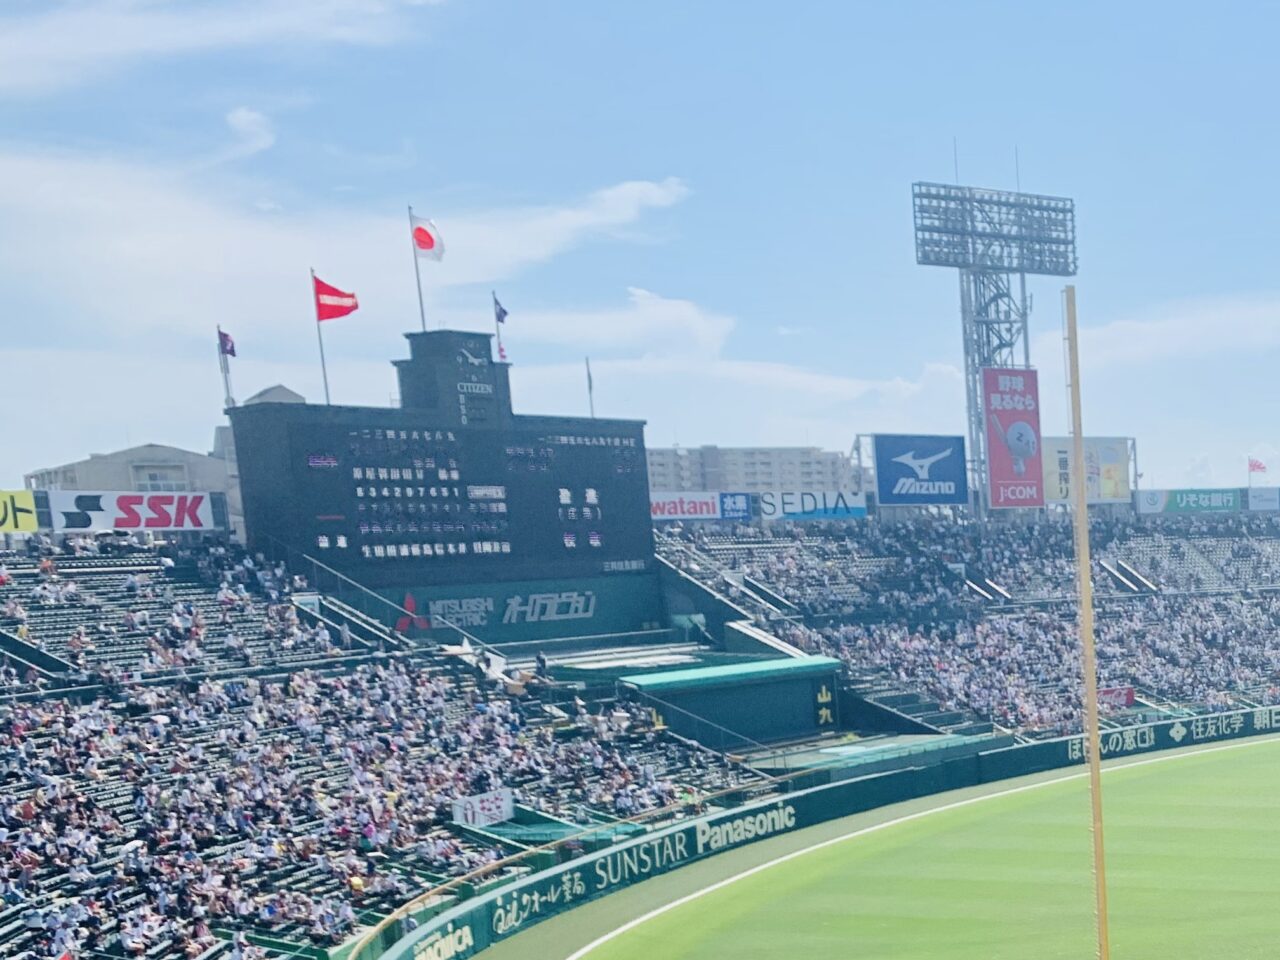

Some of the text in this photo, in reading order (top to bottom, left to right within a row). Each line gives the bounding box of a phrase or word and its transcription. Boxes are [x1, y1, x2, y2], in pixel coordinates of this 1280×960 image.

[457, 383, 493, 394] CITIZEN
[998, 375, 1025, 391] 野球
[990, 393, 1035, 411] 見るなら
[999, 486, 1037, 502] J:COM
[1177, 493, 1233, 507] りそな銀行
[113, 494, 205, 528] SSK
[650, 496, 717, 517] watani
[429, 597, 494, 614] MITSUBISHI
[1190, 712, 1244, 741] 住友化学
[1068, 728, 1150, 760] ほんの窓口
[697, 802, 796, 854] Panasonic
[595, 831, 688, 889] SUNSTAR
